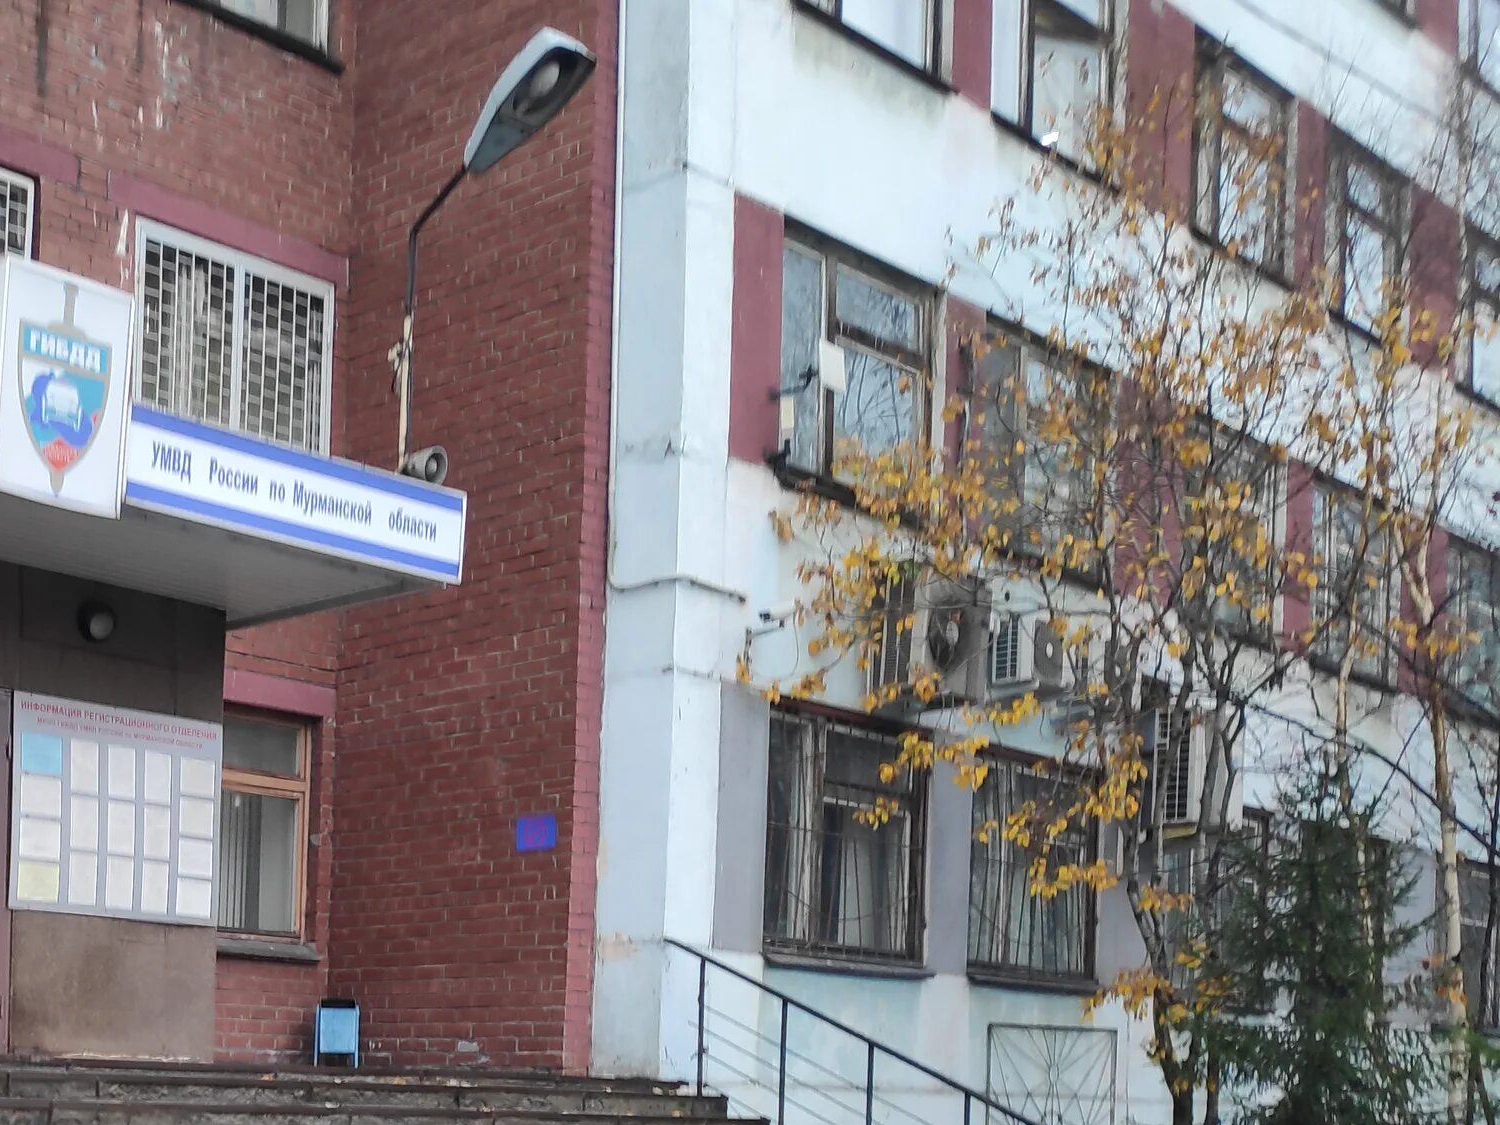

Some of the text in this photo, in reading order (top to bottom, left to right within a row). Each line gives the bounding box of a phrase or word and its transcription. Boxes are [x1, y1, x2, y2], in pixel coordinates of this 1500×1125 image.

[30, 327, 101, 374] ГИБДД
[151, 440, 437, 543] УМВД России по Мурманской области
[21, 700, 82, 718] ИНФОРМАЦИЯ
[84, 711, 169, 734] РЕГИСТРАЦИОННОГО
